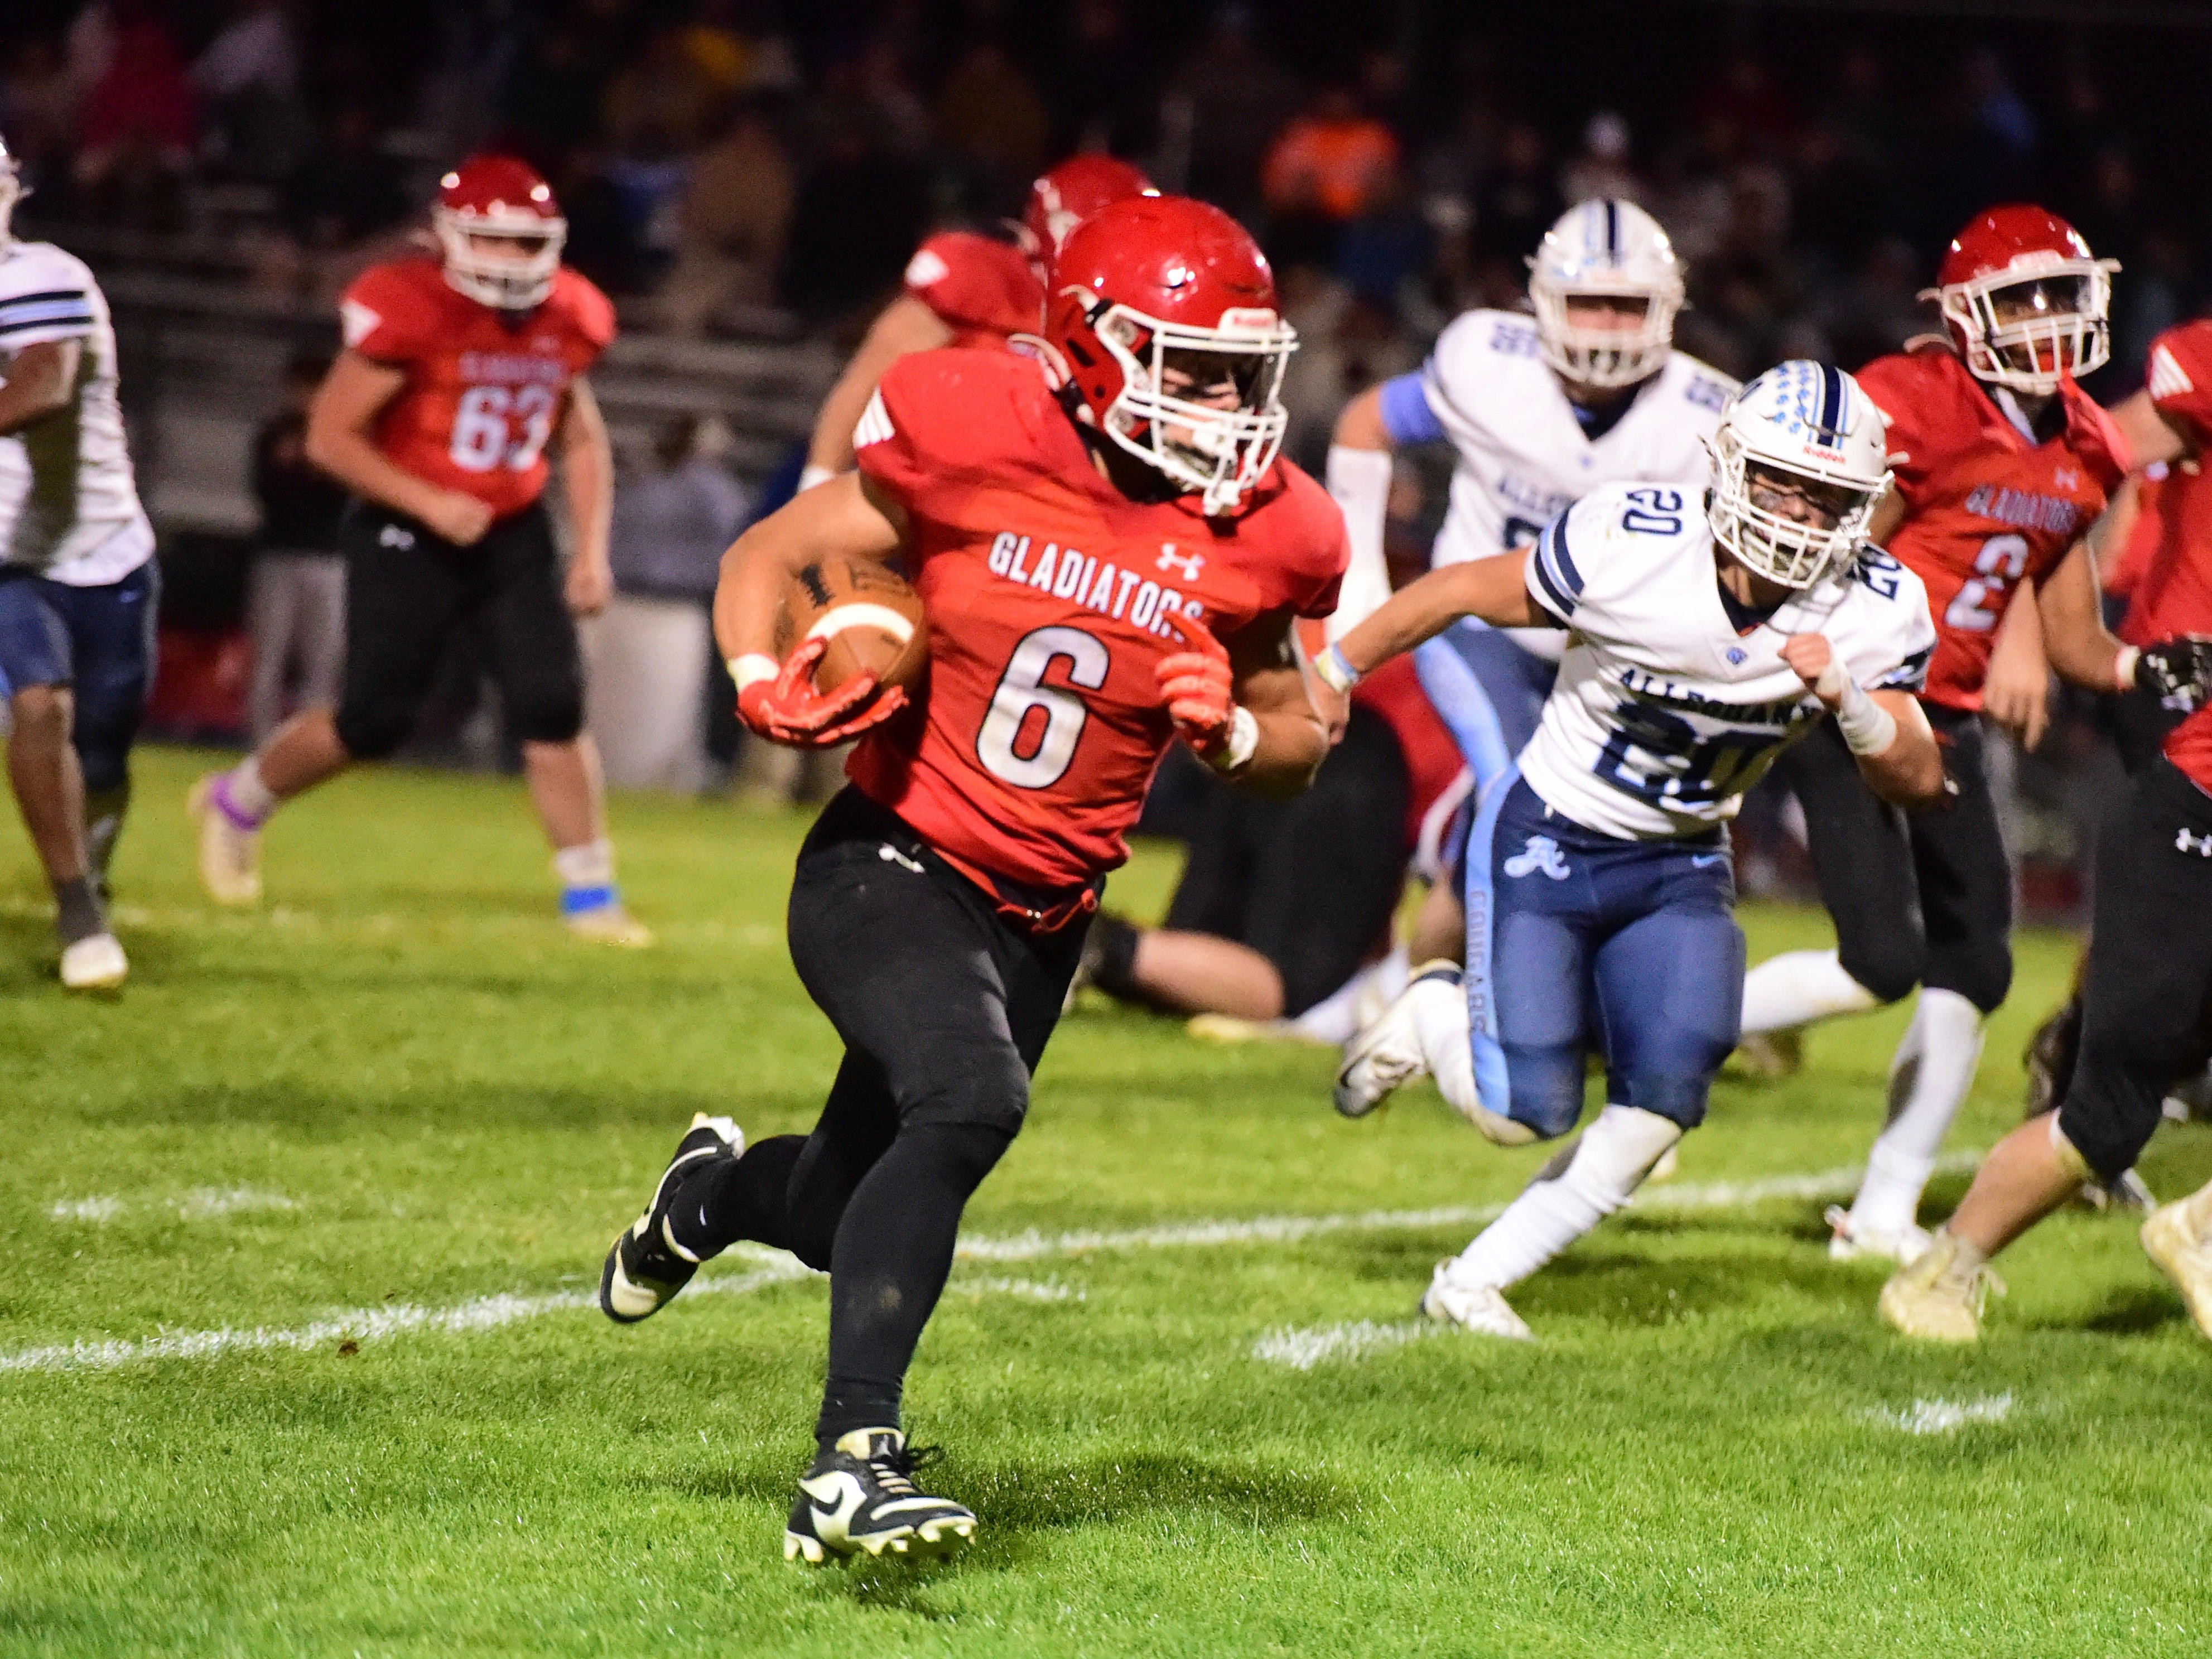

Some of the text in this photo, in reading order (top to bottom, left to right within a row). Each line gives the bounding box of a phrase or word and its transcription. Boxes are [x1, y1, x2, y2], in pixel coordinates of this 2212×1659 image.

[1622, 488, 1683, 536] 20
[1945, 534, 2028, 632] 2
[976, 625, 1110, 790] 6
